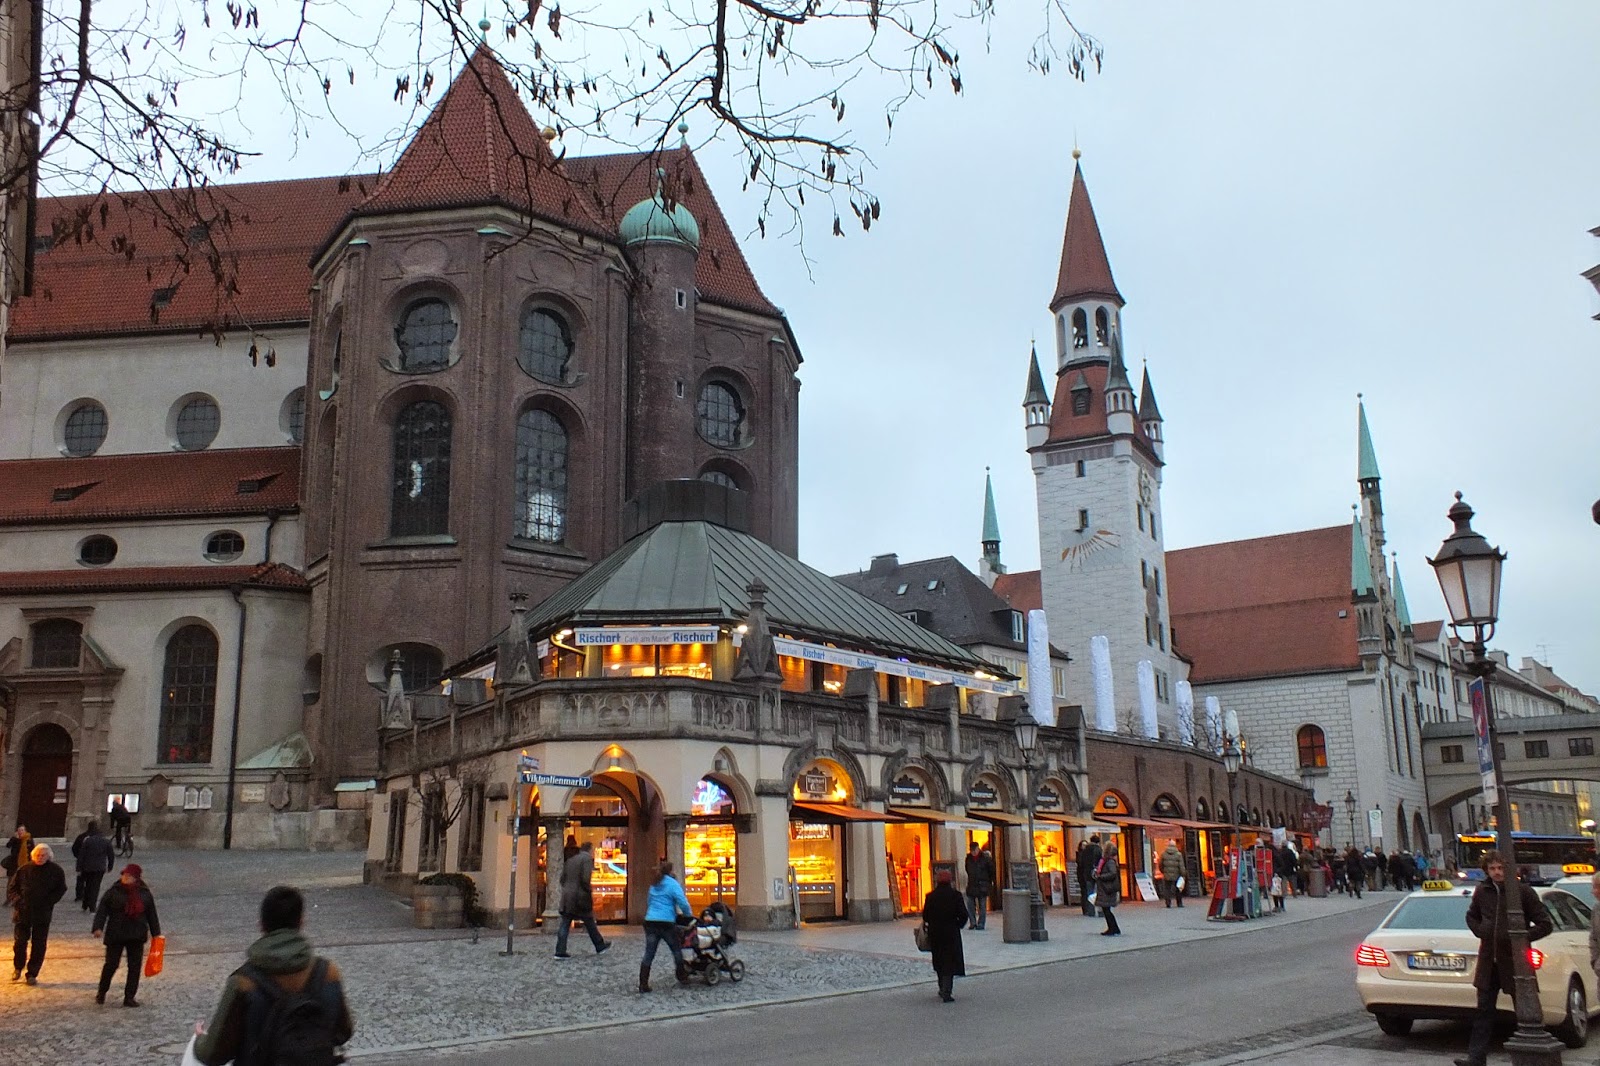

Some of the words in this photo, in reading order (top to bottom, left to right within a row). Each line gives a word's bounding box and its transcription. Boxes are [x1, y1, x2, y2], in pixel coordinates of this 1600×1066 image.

[579, 633, 621, 643] Rischart
[673, 632, 714, 642] Rischart
[802, 647, 825, 660] Rischart
[526, 773, 587, 787] Viktualienmarkt
[1424, 881, 1446, 889] TAXI
